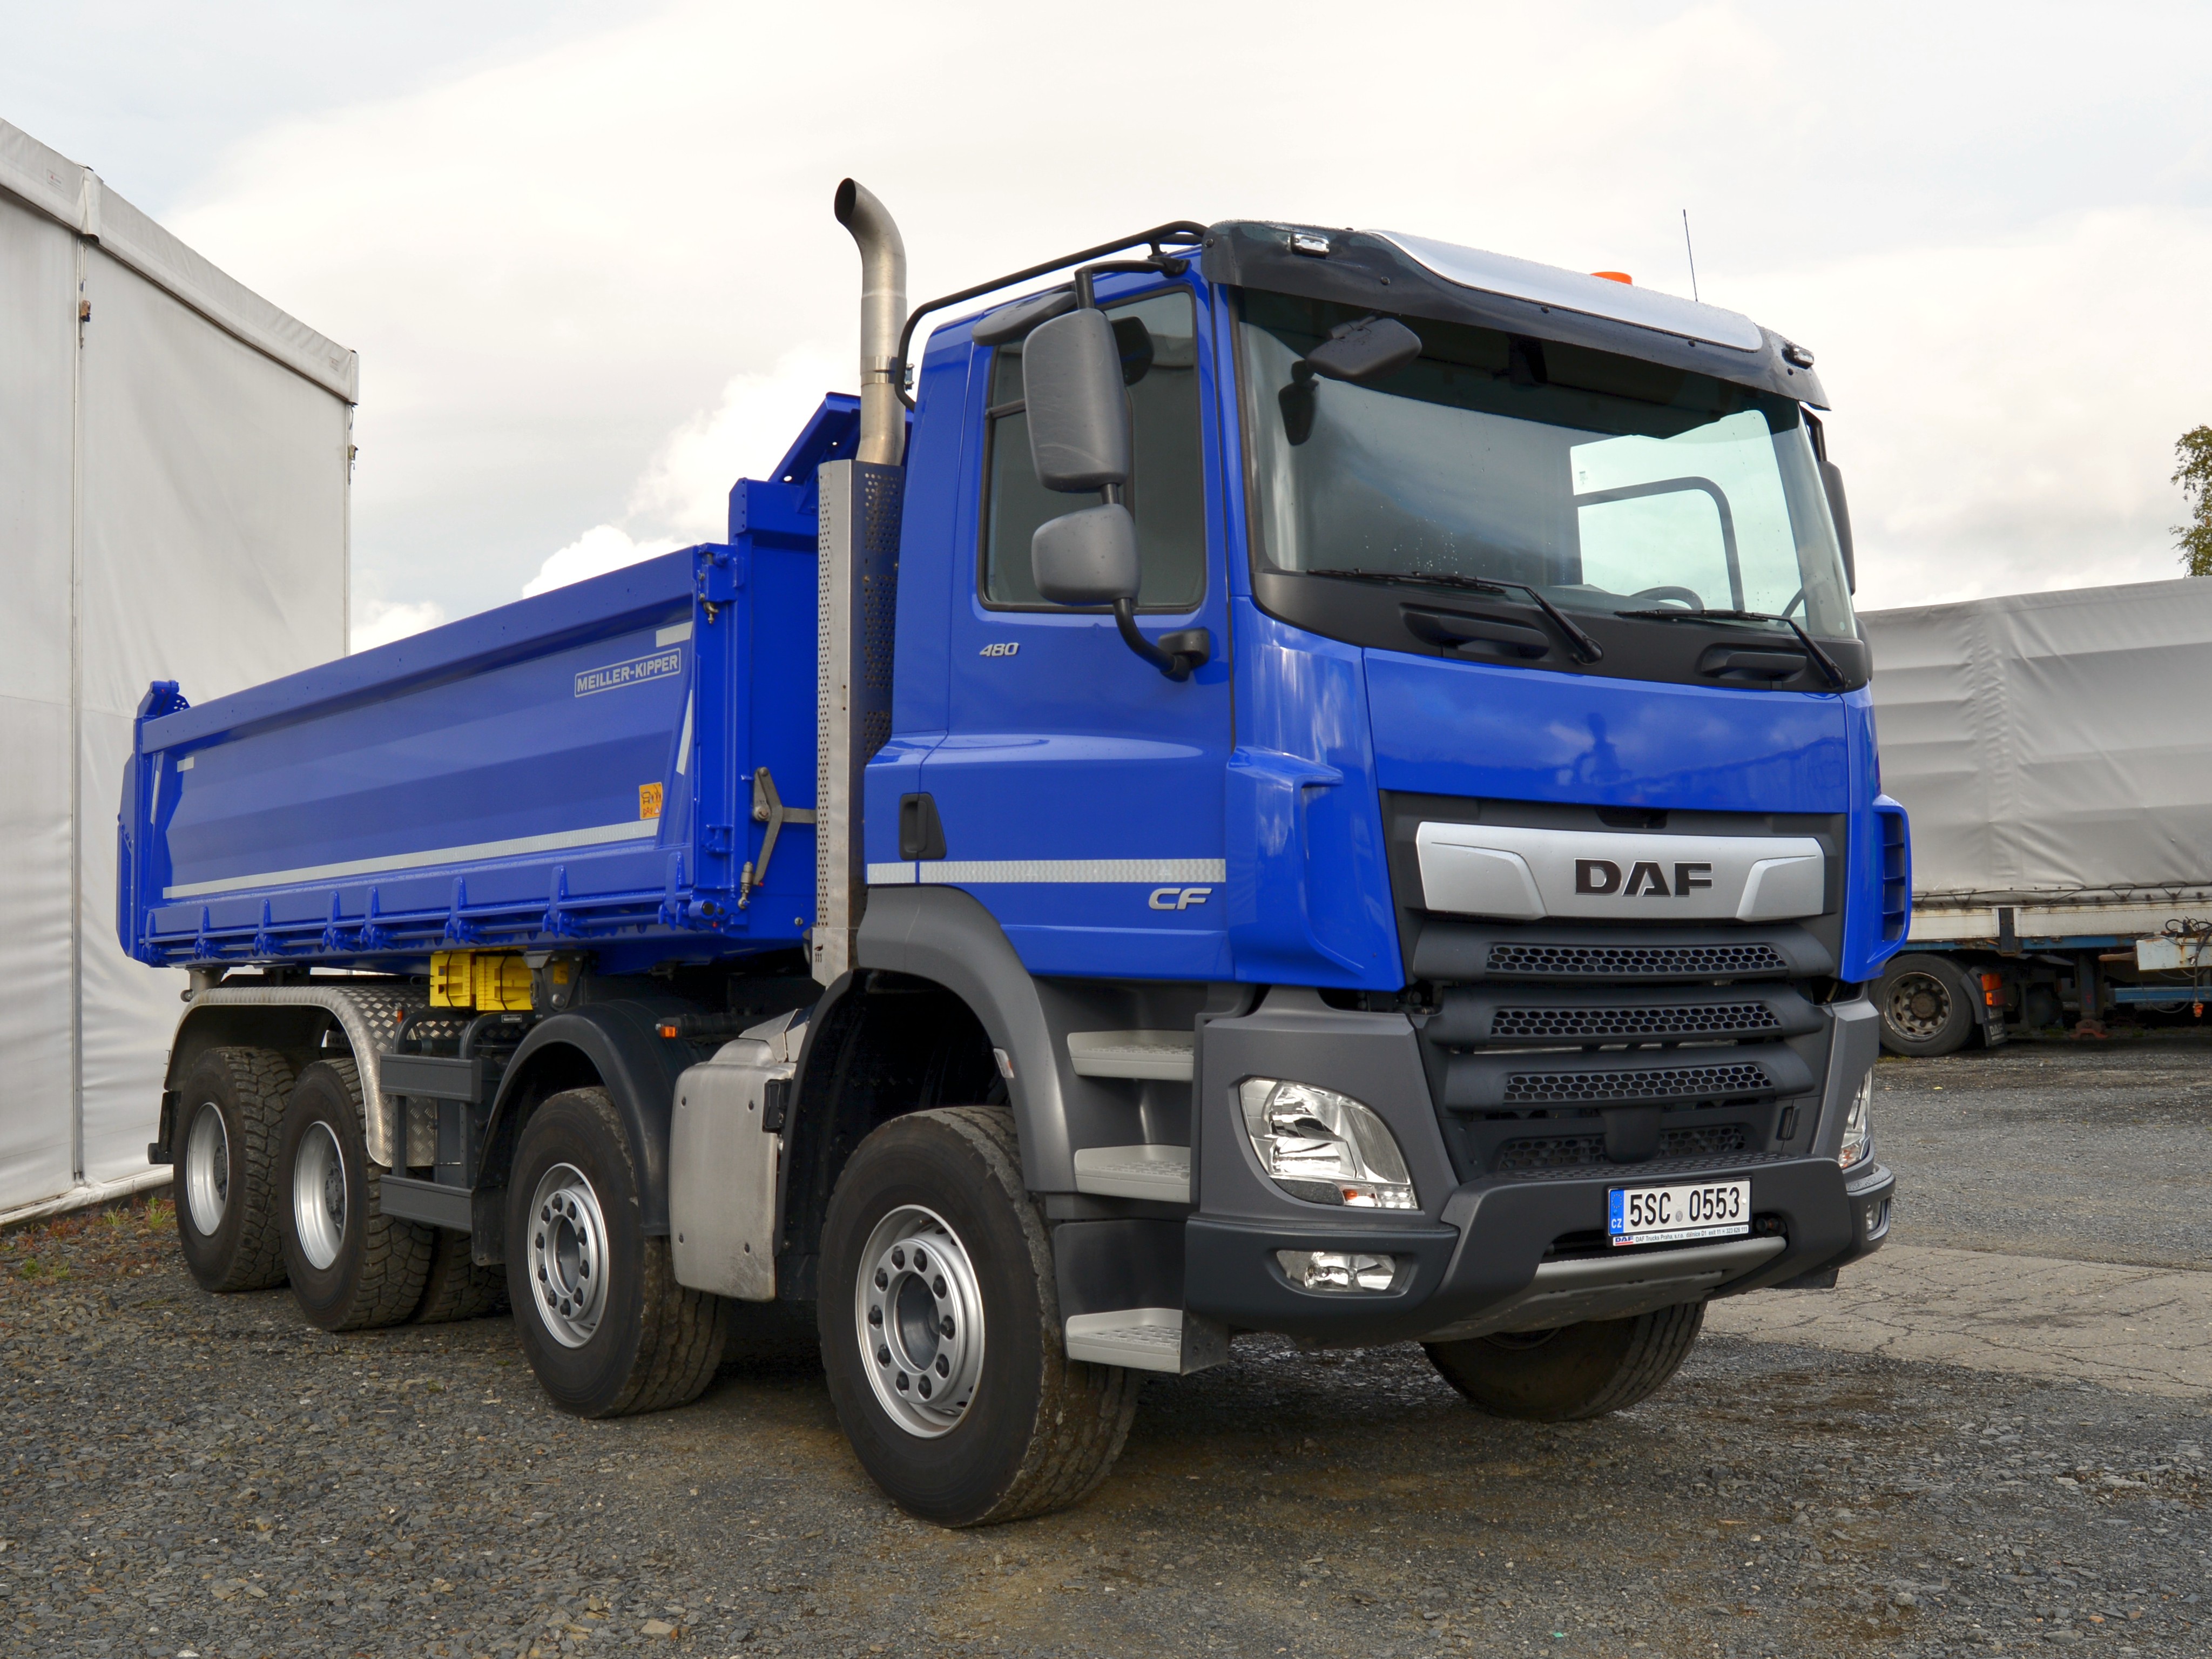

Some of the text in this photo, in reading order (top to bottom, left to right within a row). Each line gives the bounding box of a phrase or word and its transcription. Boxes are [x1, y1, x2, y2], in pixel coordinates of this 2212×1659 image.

[979, 642, 1020, 657] 480
[577, 655, 678, 692] MEILLER-KIPPER
[1575, 858, 1712, 898] DAF
[1148, 887, 1212, 910] CF
[1989, 1023, 2003, 1035] DAF
[1630, 1186, 1740, 1226] 5SC 0553
[1611, 1218, 1622, 1229] CZ
